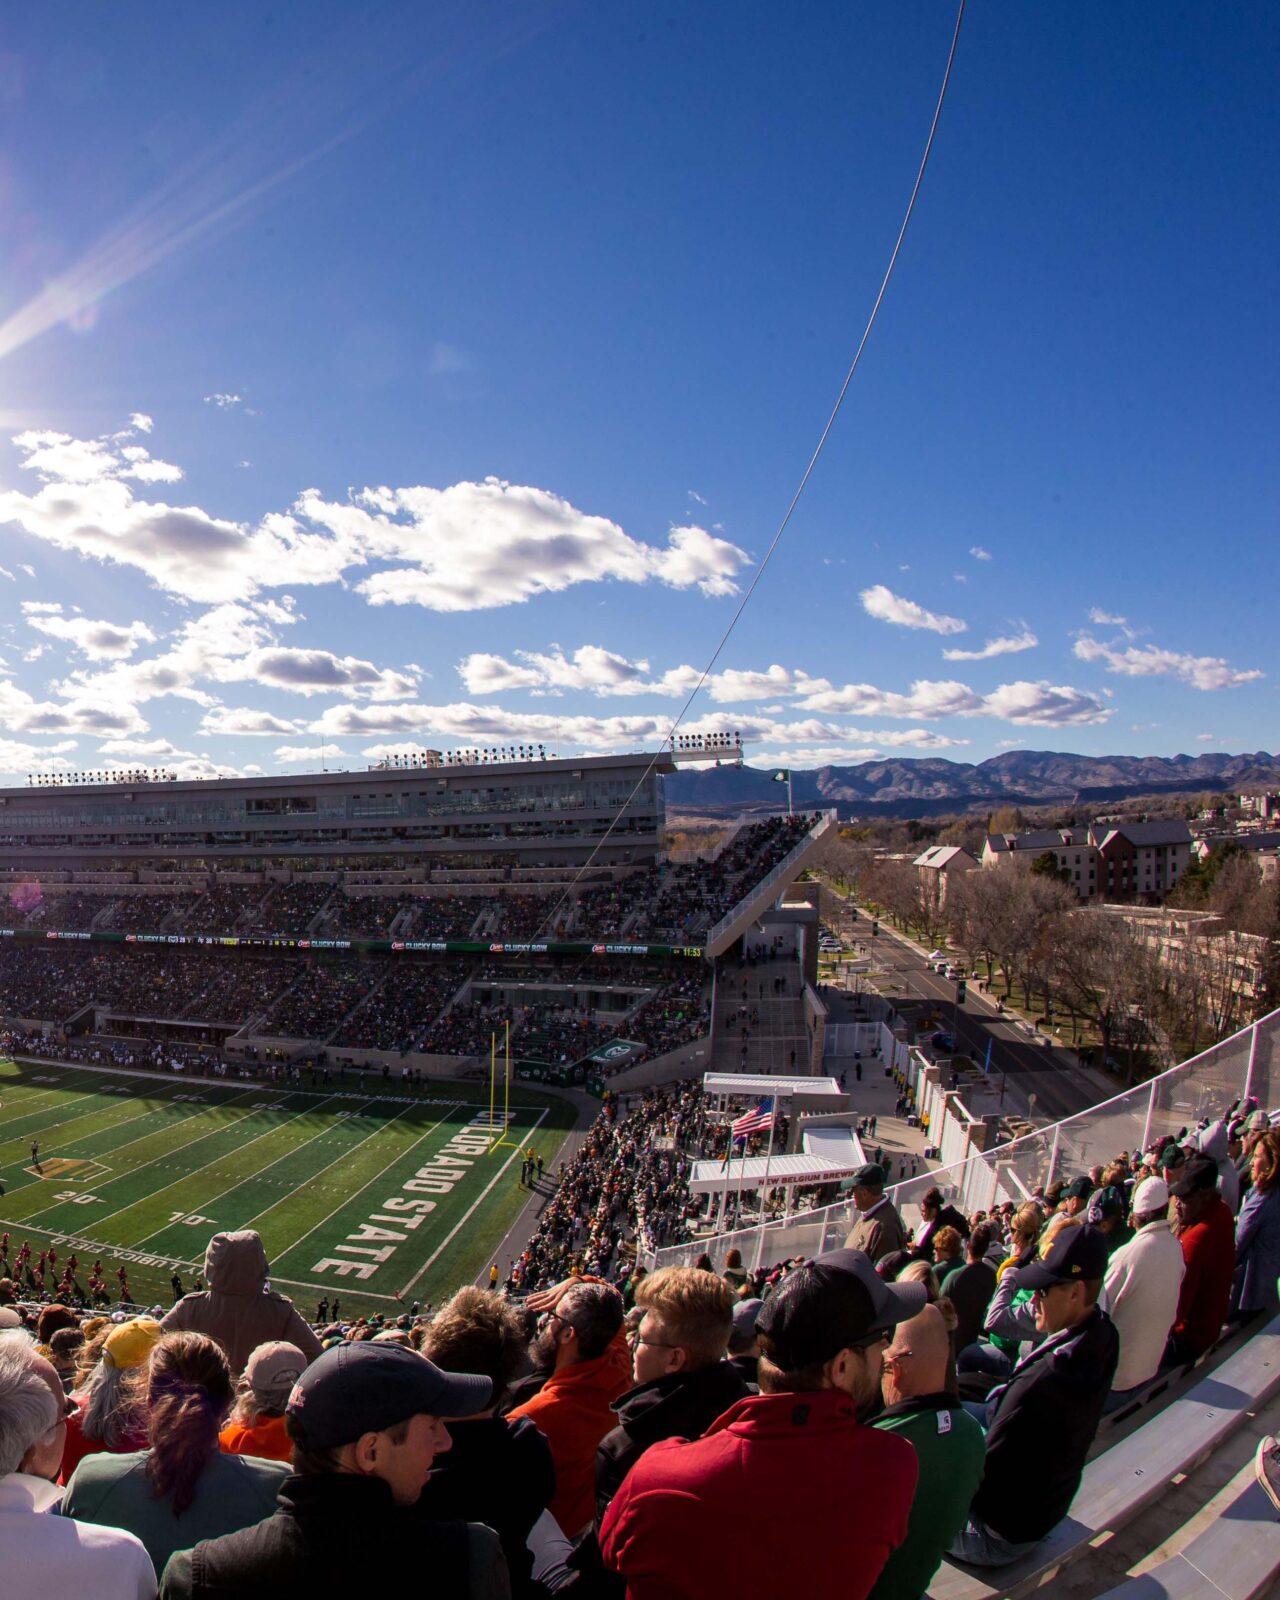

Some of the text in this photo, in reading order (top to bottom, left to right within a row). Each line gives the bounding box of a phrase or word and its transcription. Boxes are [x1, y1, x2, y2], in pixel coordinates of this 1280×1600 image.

[684, 948, 700, 957] 11:53
[758, 1170, 856, 1186] NEW BELGIUM BREWIN
[52, 1190, 98, 1204] 20
[309, 1110, 517, 1280] COLORADO STATE
[169, 1211, 207, 1226] 10
[51, 1237, 181, 1271] LUBICK FIELD
